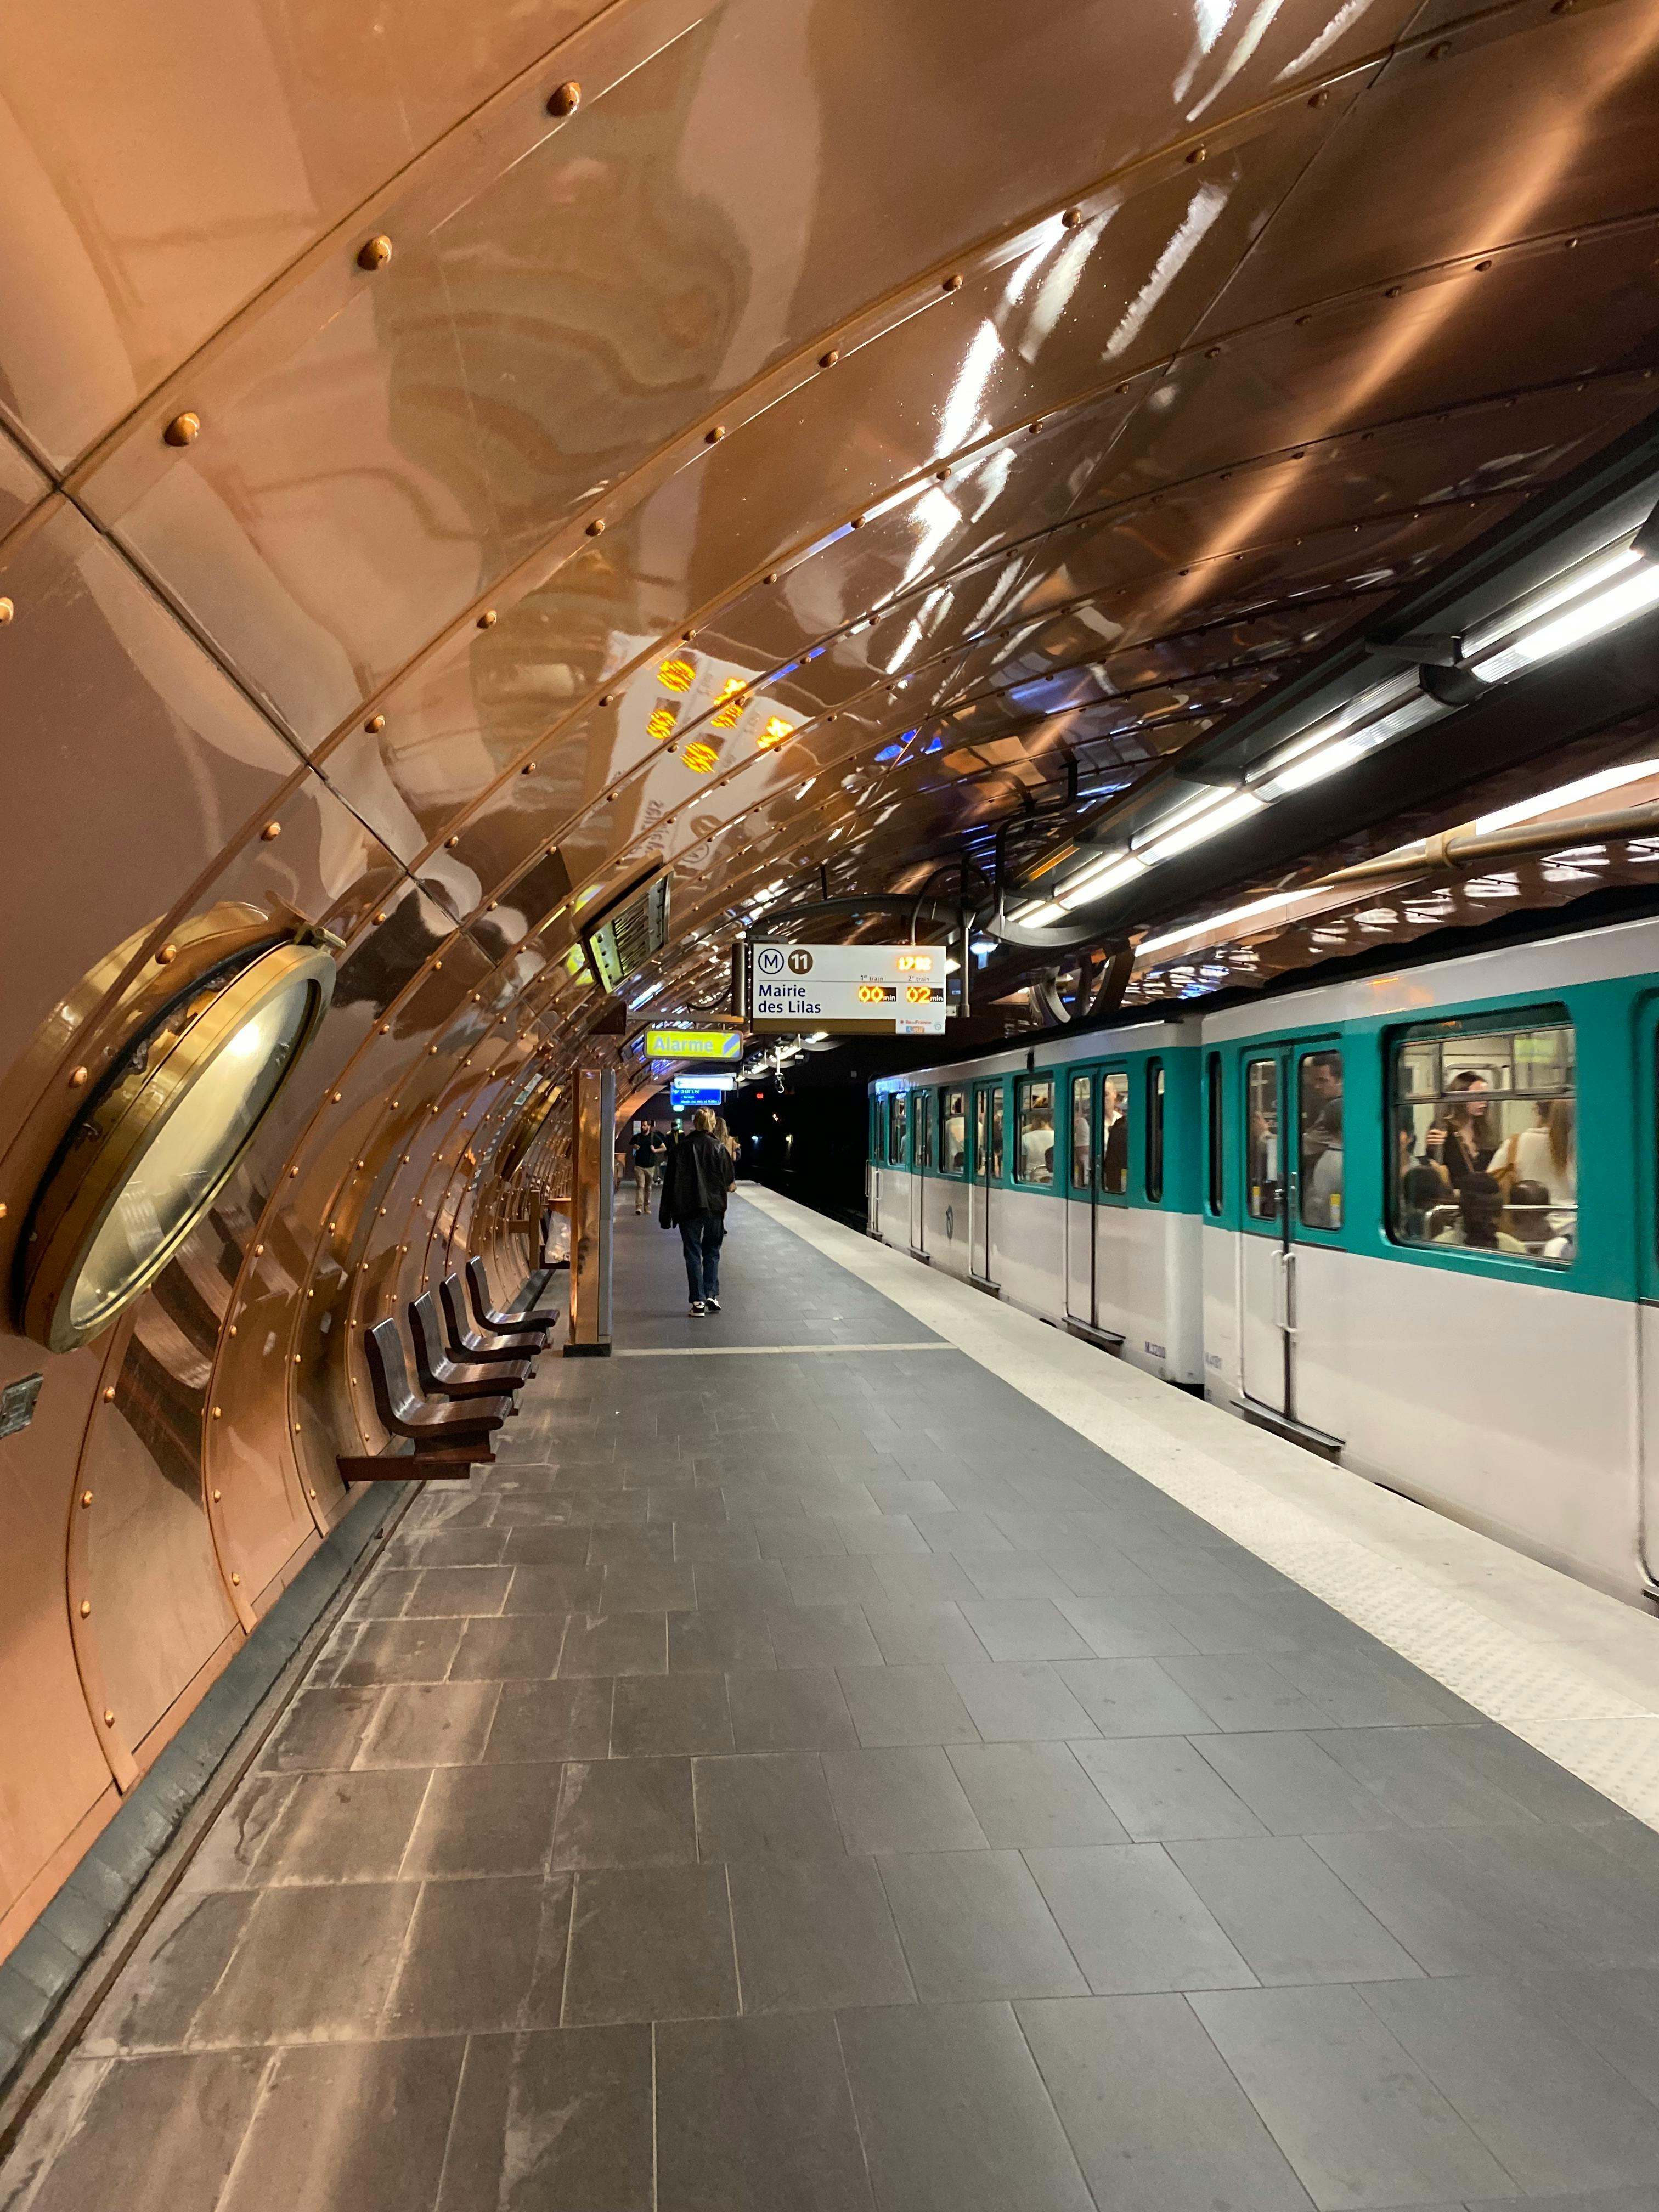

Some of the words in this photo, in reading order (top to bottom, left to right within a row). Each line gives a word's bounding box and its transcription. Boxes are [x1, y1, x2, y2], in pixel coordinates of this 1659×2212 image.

[791, 953, 808, 969] 11
[759, 984, 806, 997] Mairie
[859, 986, 883, 1003] 00
[906, 986, 930, 1004] 02
[758, 1000, 783, 1013] des
[788, 1000, 821, 1013] Lilas
[653, 1035, 713, 1052] Alarme
